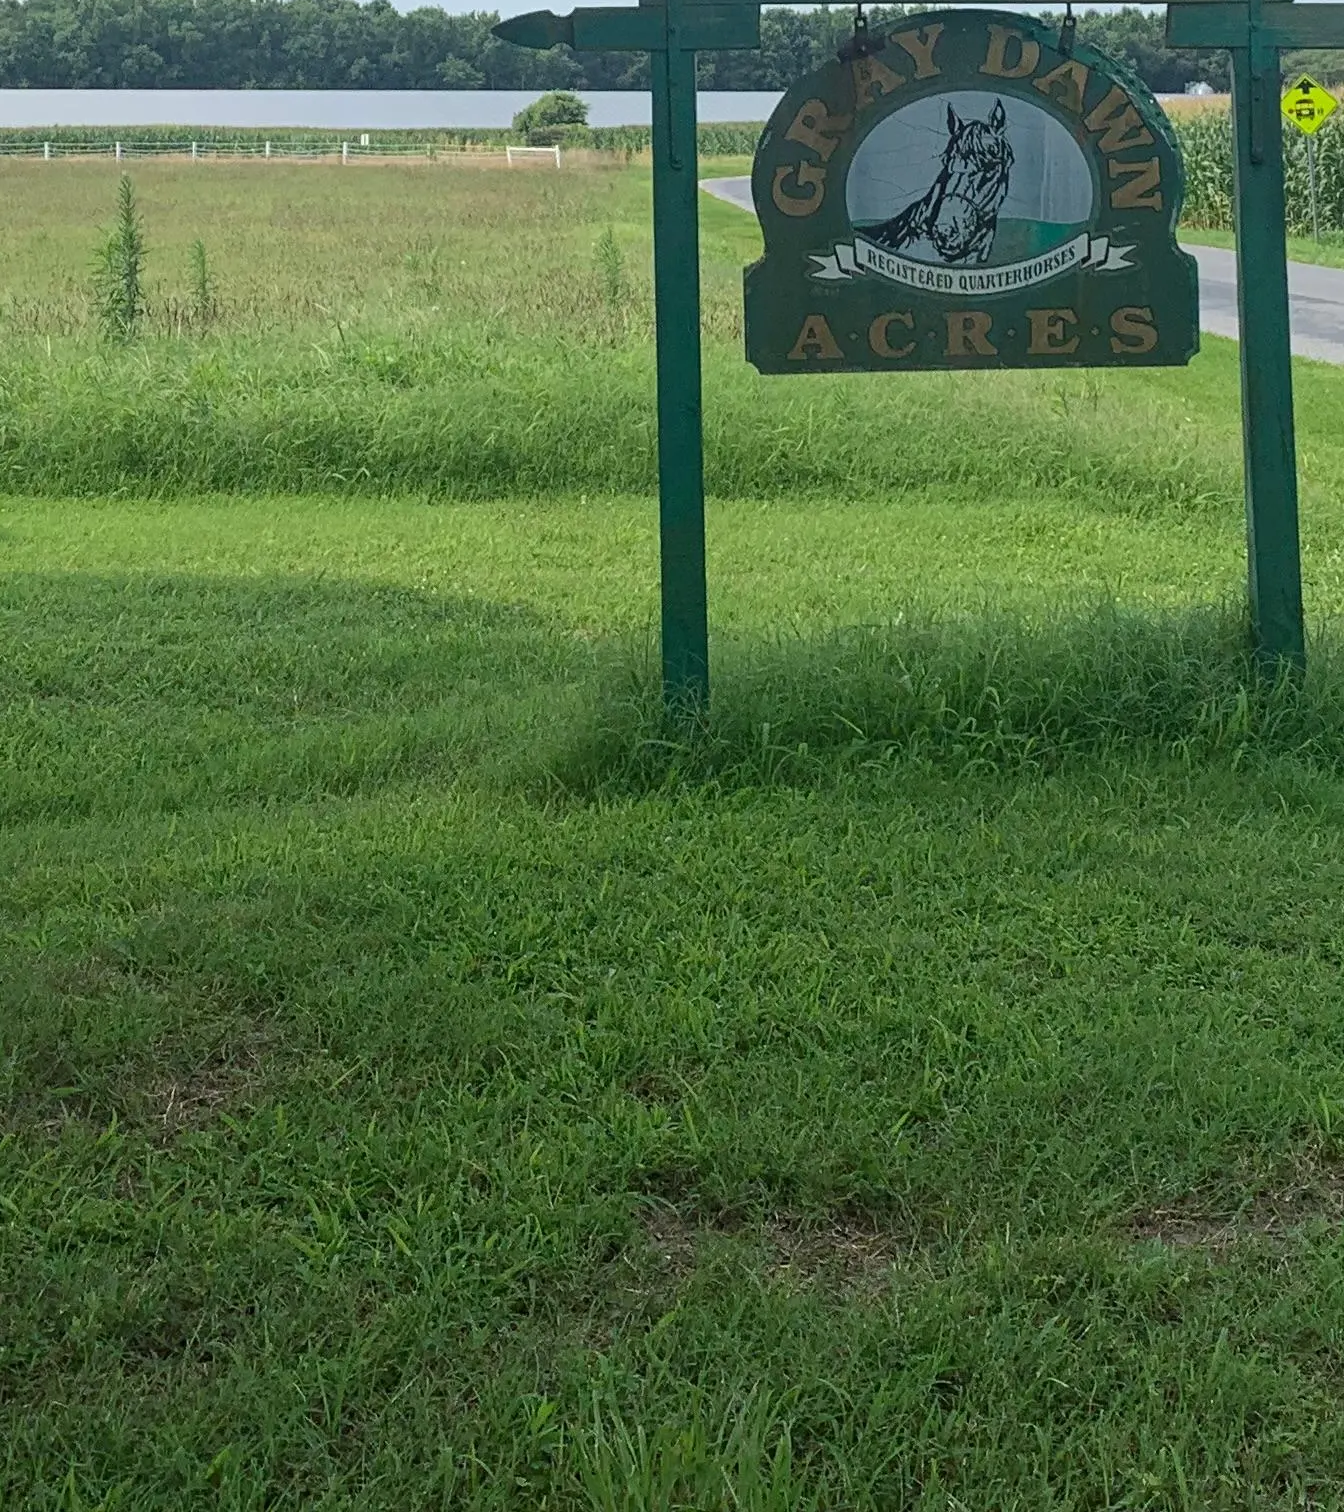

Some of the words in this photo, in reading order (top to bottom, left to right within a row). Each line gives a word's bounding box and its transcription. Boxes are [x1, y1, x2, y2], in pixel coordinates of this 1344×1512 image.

[772, 22, 945, 217] GRAY
[978, 23, 1163, 212] DAWN
[867, 248, 953, 289] REGISTERED
[959, 245, 1076, 292] QUARTERHORSES
